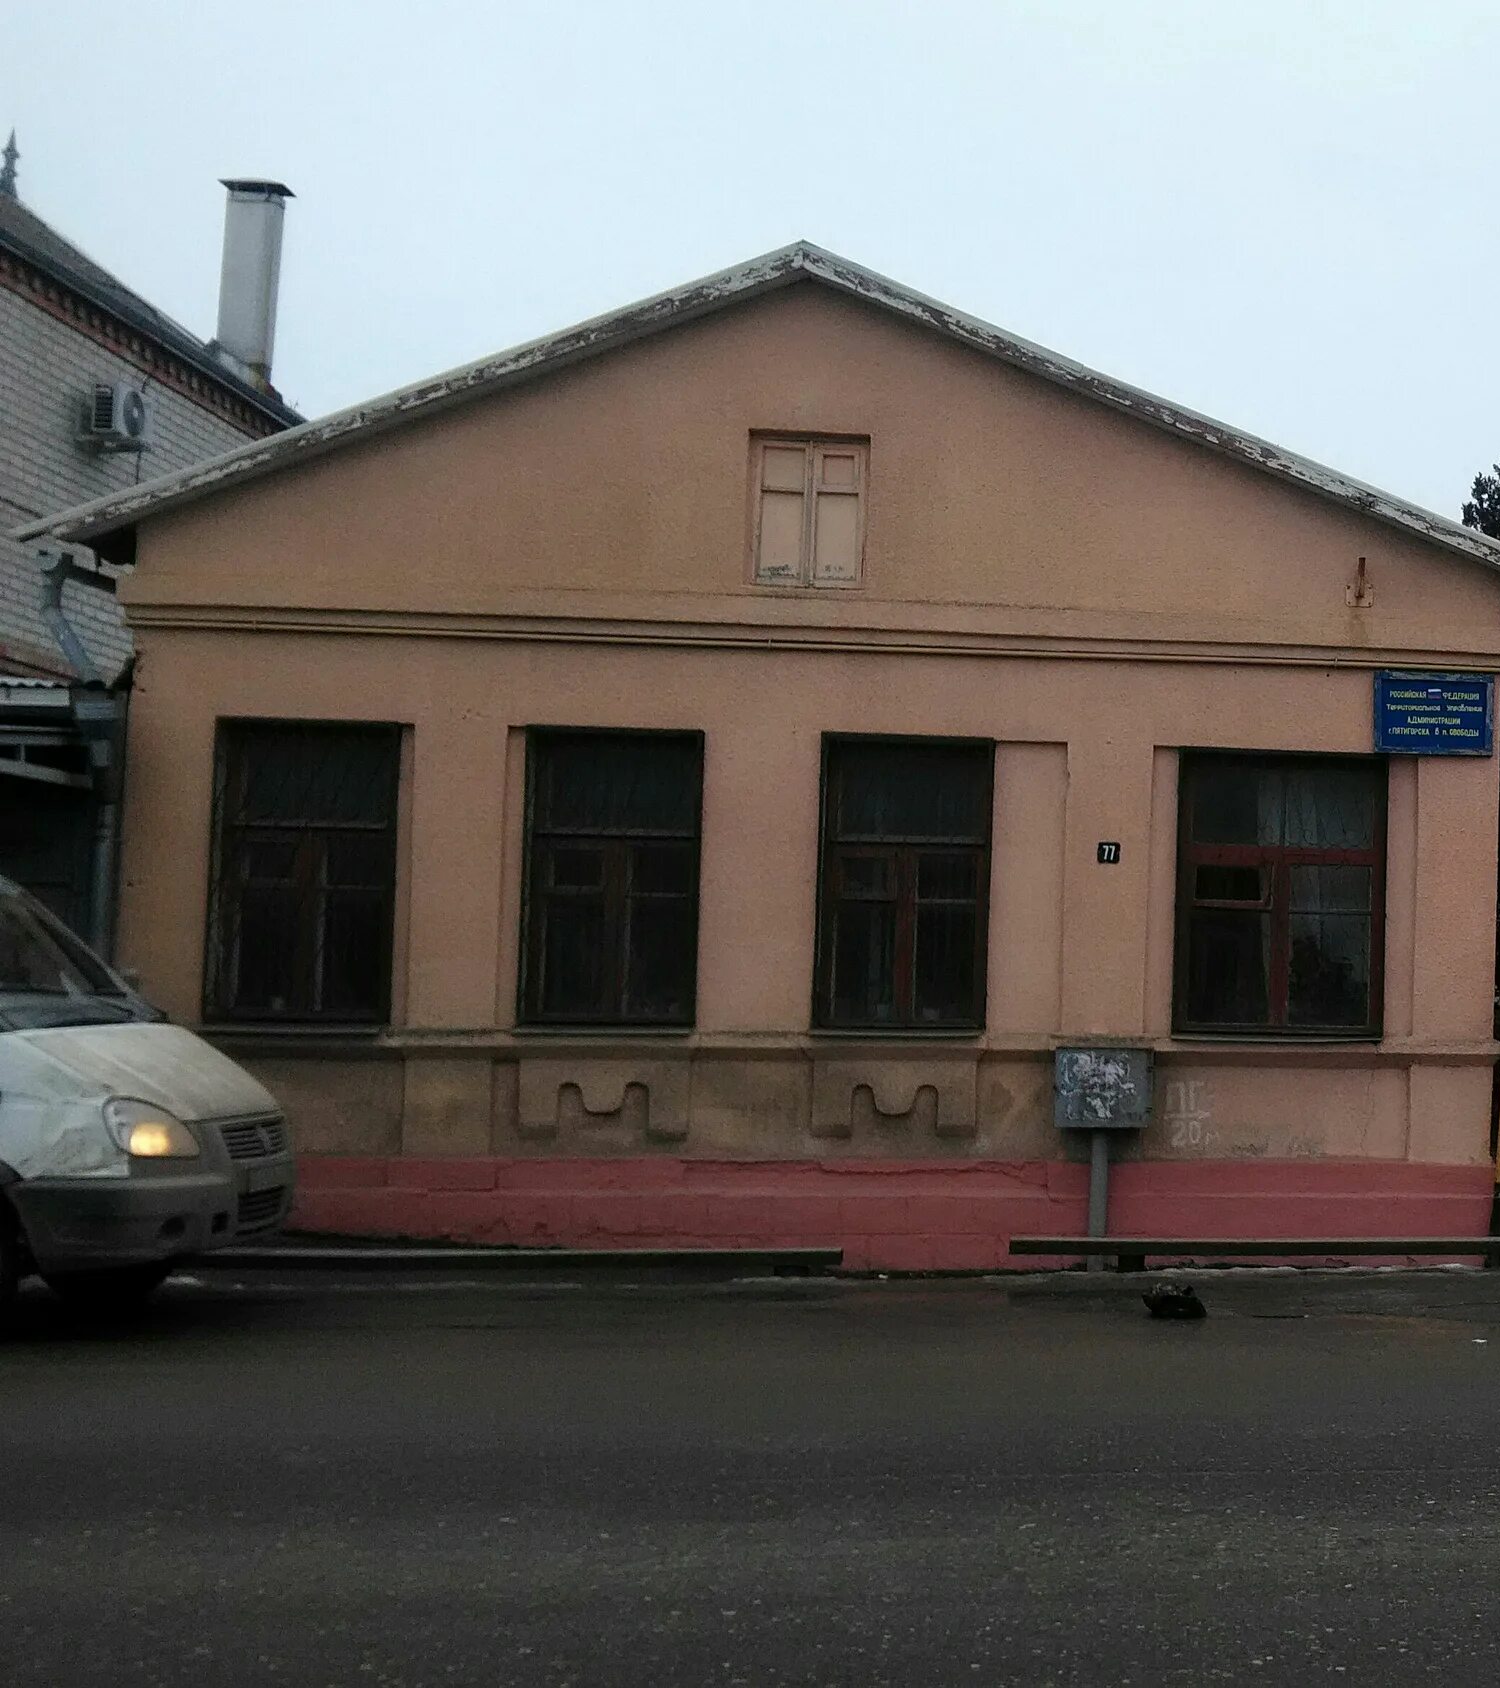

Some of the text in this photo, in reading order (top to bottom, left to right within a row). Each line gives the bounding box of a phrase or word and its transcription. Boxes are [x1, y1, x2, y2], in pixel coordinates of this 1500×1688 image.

[1442, 692, 1480, 701] ФЕДЕРАЦИЯ
[1407, 715, 1461, 725] АДМИНИСТРАЦИИ
[1449, 729, 1480, 737] СВОБОДЫ
[1102, 845, 1116, 861] 77
